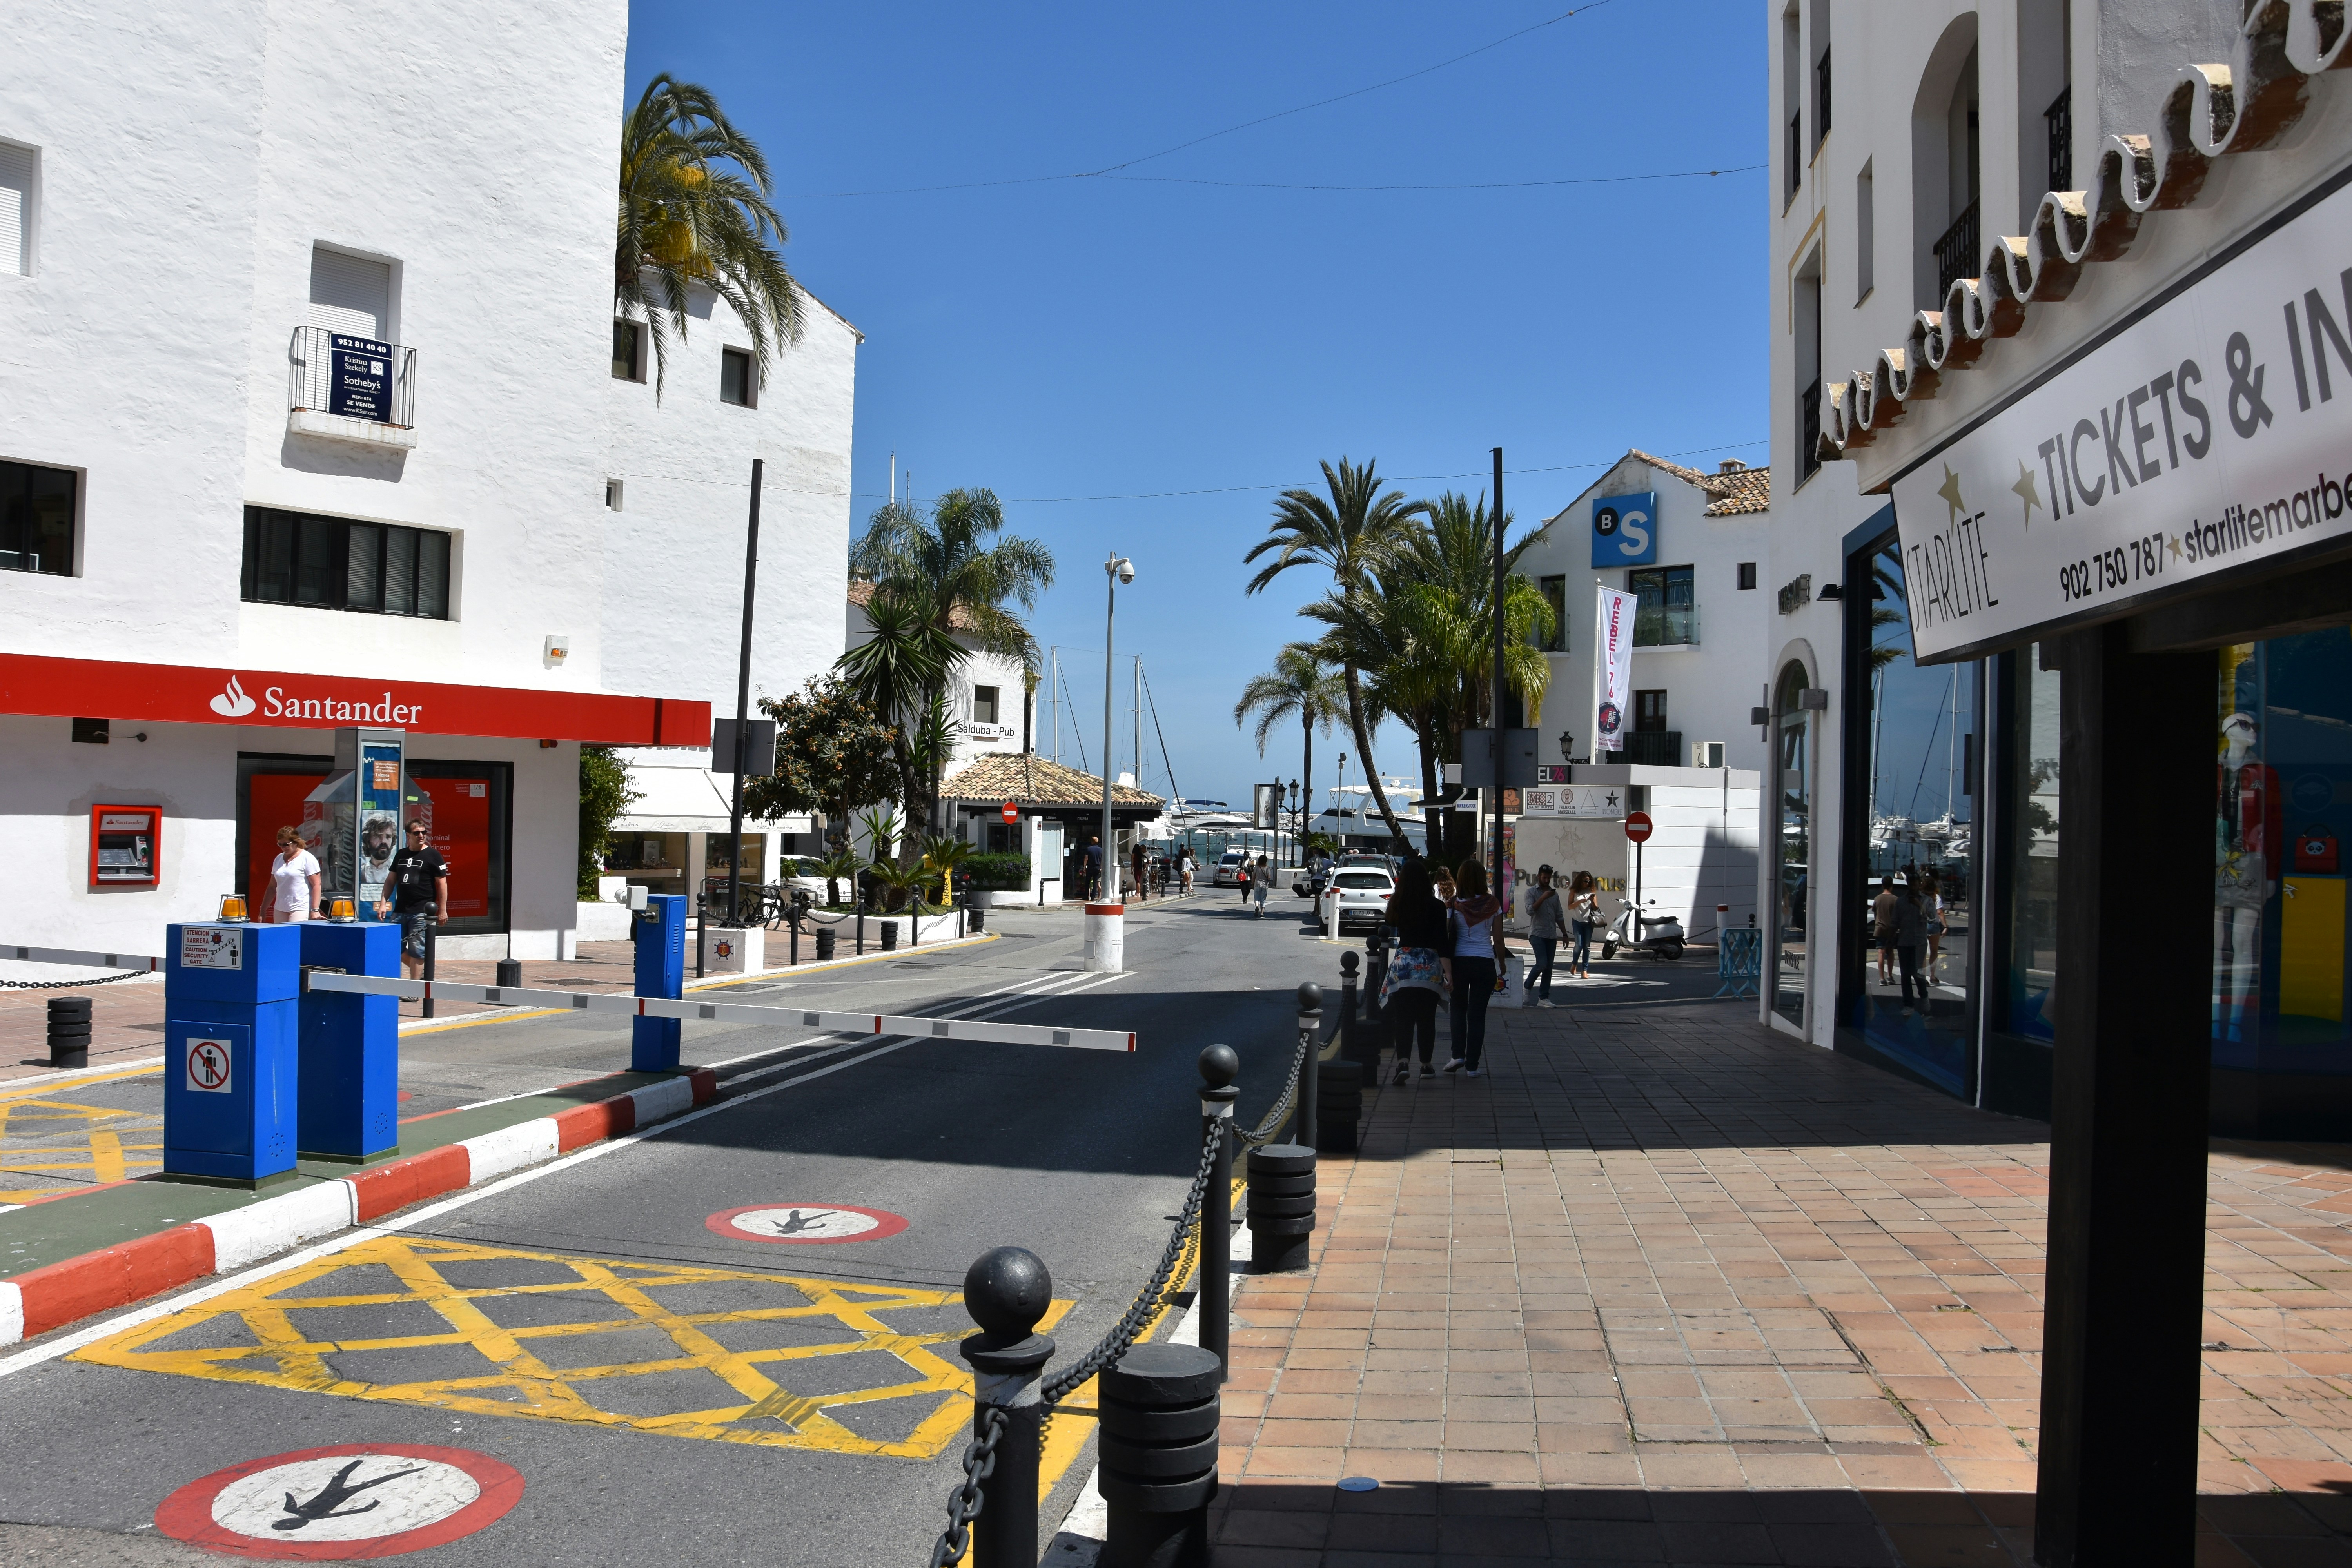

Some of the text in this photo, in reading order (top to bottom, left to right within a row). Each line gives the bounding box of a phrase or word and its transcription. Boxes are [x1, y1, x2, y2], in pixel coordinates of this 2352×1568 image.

[338, 338, 353, 347] 952
[345, 356, 368, 365] Kristina
[345, 363, 368, 374] Szekely
[344, 375, 381, 390] Sotheby's
[2038, 359, 2211, 521] TICKETS
[2225, 331, 2273, 439] &
[1602, 511, 1649, 556] B S
[1906, 511, 1998, 632] STARLITE
[2060, 557, 2092, 603] 902
[2093, 546, 2127, 593] 750
[2130, 531, 2165, 578] 787
[1609, 596, 1621, 666] REBEL
[1609, 671, 1614, 699] 76
[264, 687, 422, 724] Santander
[958, 724, 991, 735] Salduba
[999, 727, 1014, 736] Pub
[1515, 869, 1570, 889] Puto
